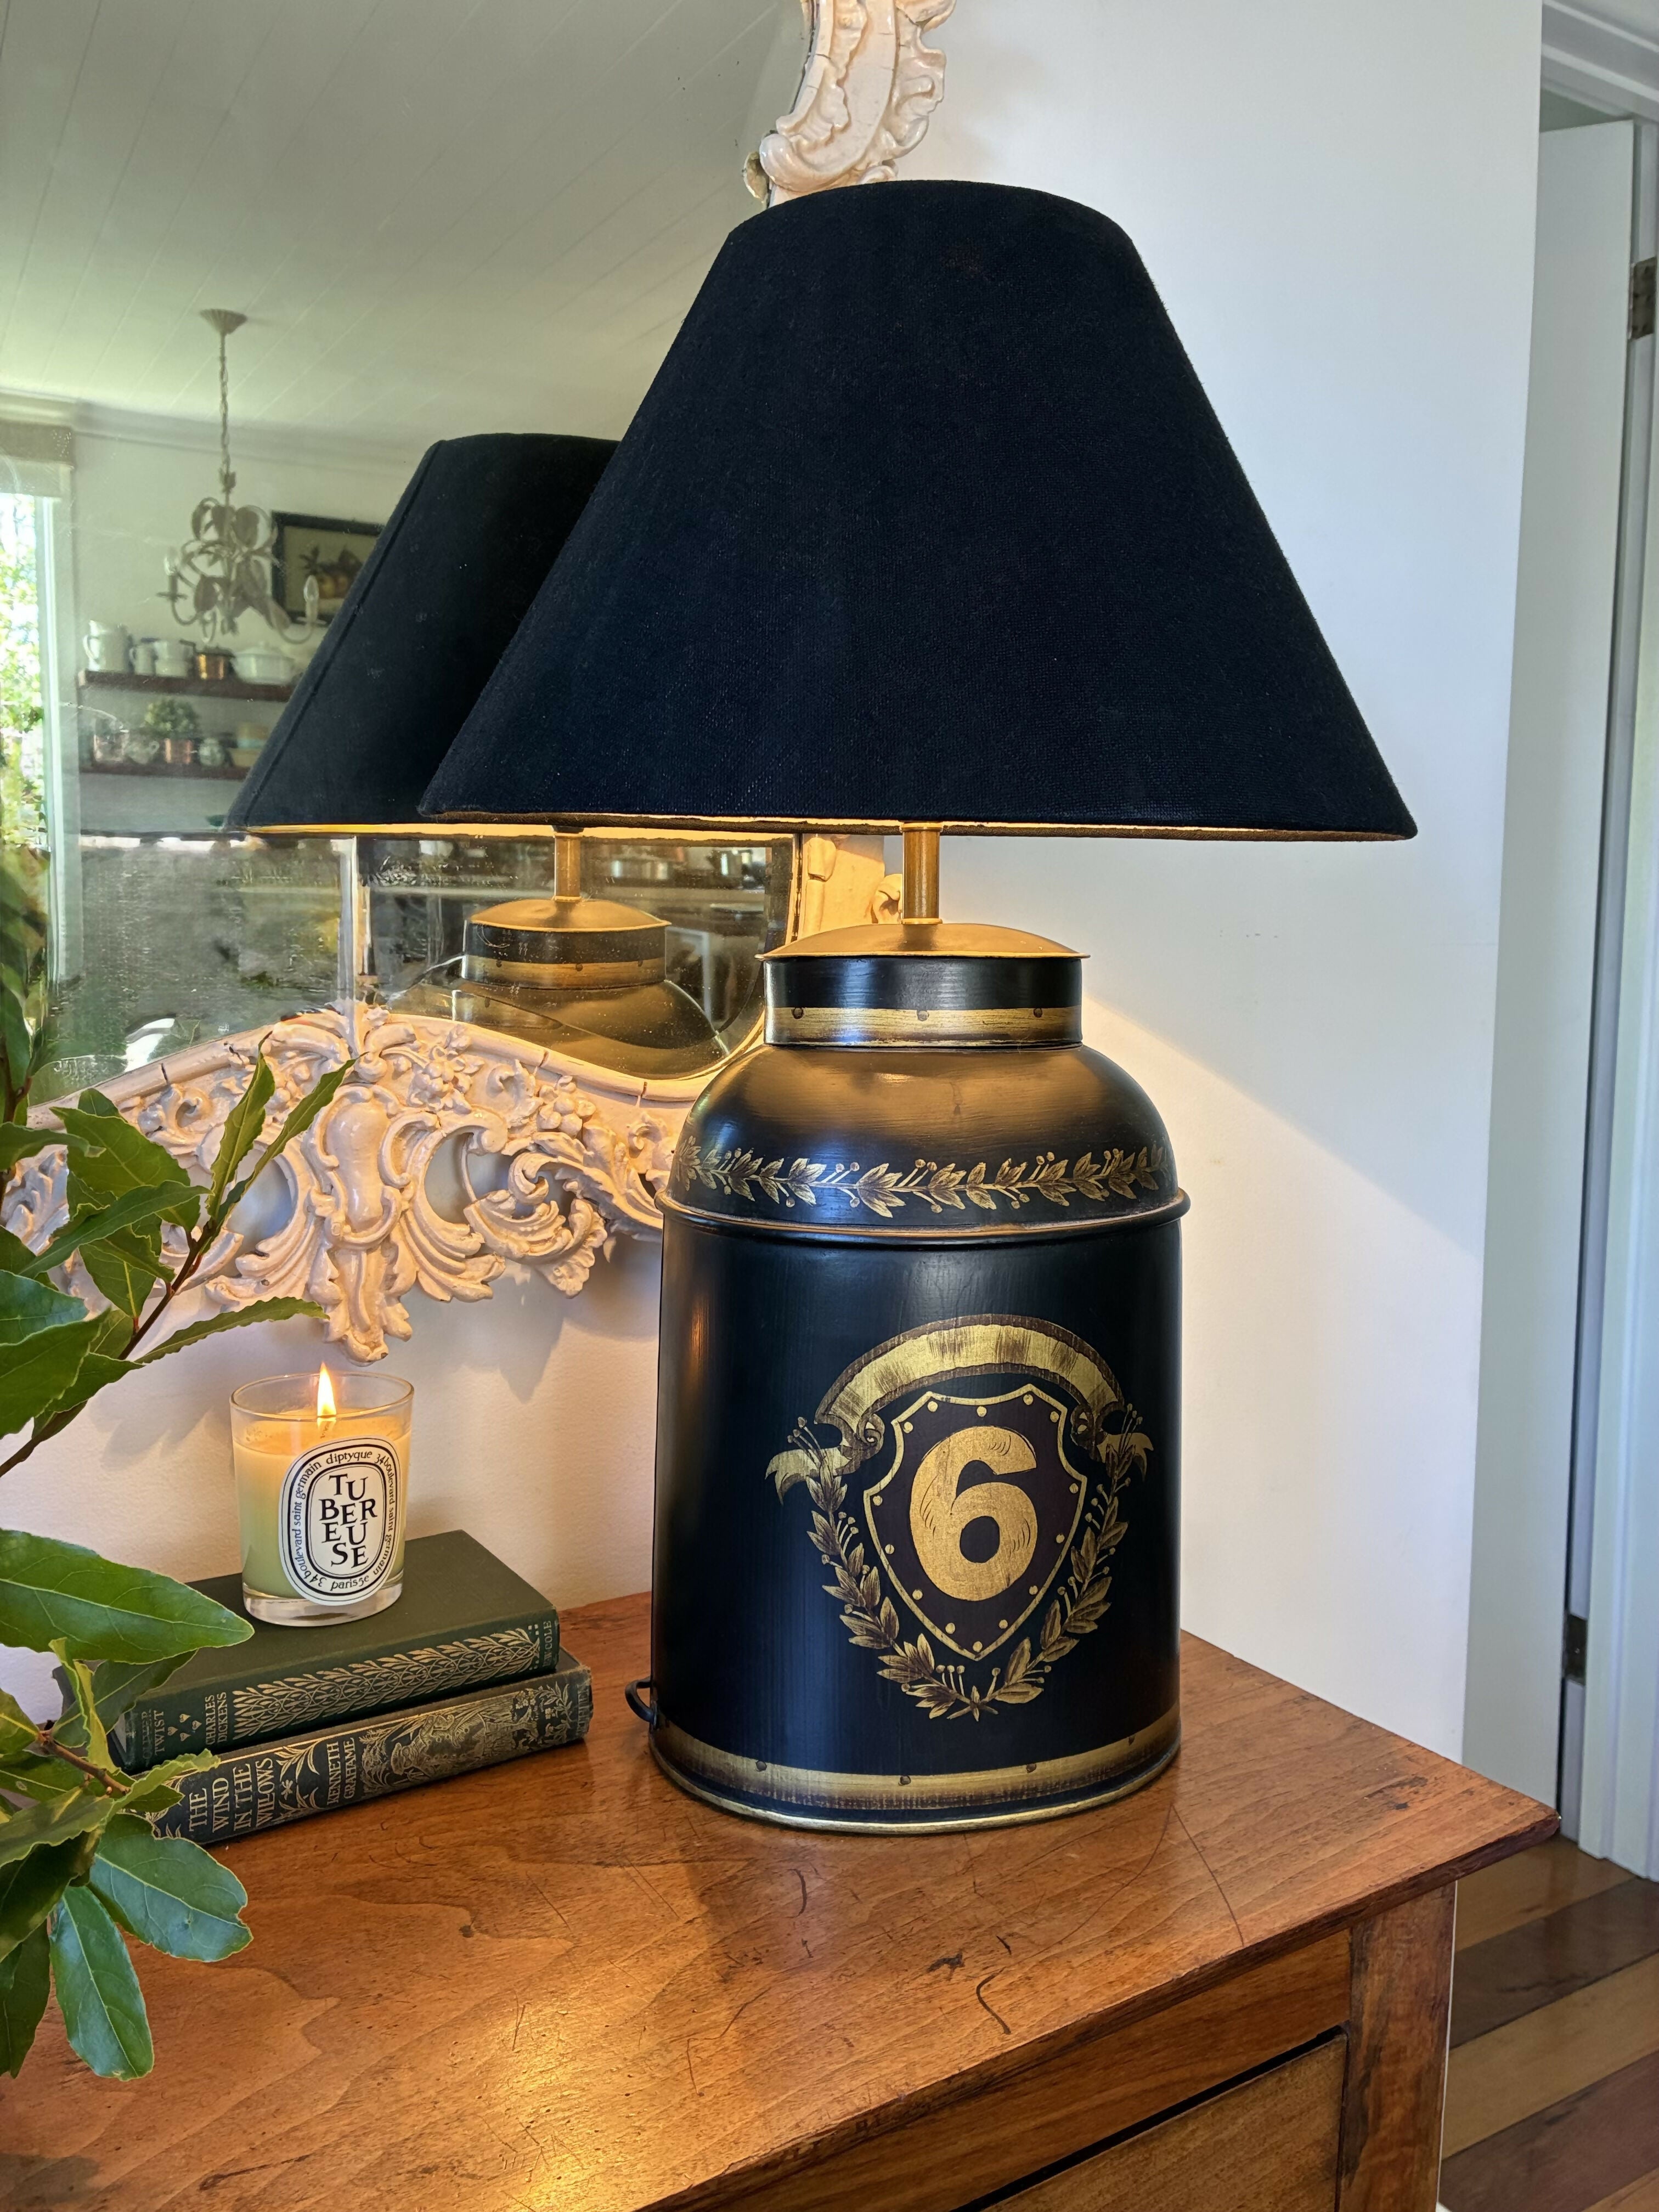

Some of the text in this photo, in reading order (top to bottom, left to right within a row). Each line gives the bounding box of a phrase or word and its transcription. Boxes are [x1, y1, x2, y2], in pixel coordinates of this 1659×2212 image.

[326, 1451, 373, 1464] diptyque
[296, 1462, 322, 1500] germain
[329, 1473, 369, 1500] TU
[292, 1502, 302, 1526] saint
[318, 1498, 377, 1526] BER
[321, 1522, 369, 1545] EU
[909, 1425, 1039, 1602] 6
[330, 1542, 369, 1568] SE
[153, 1710, 165, 1756] TWIST
[205, 1695, 216, 1745] CHARLES
[217, 1692, 228, 1742] DICKENS
[326, 1741, 341, 1805] KENNETH
[343, 1737, 357, 1799] GRAHAME
[189, 1787, 207, 1832] THE
[212, 1778, 230, 1833] WIND
[233, 1763, 252, 1831] IN THE
[255, 1757, 275, 1827] WILLOWS
